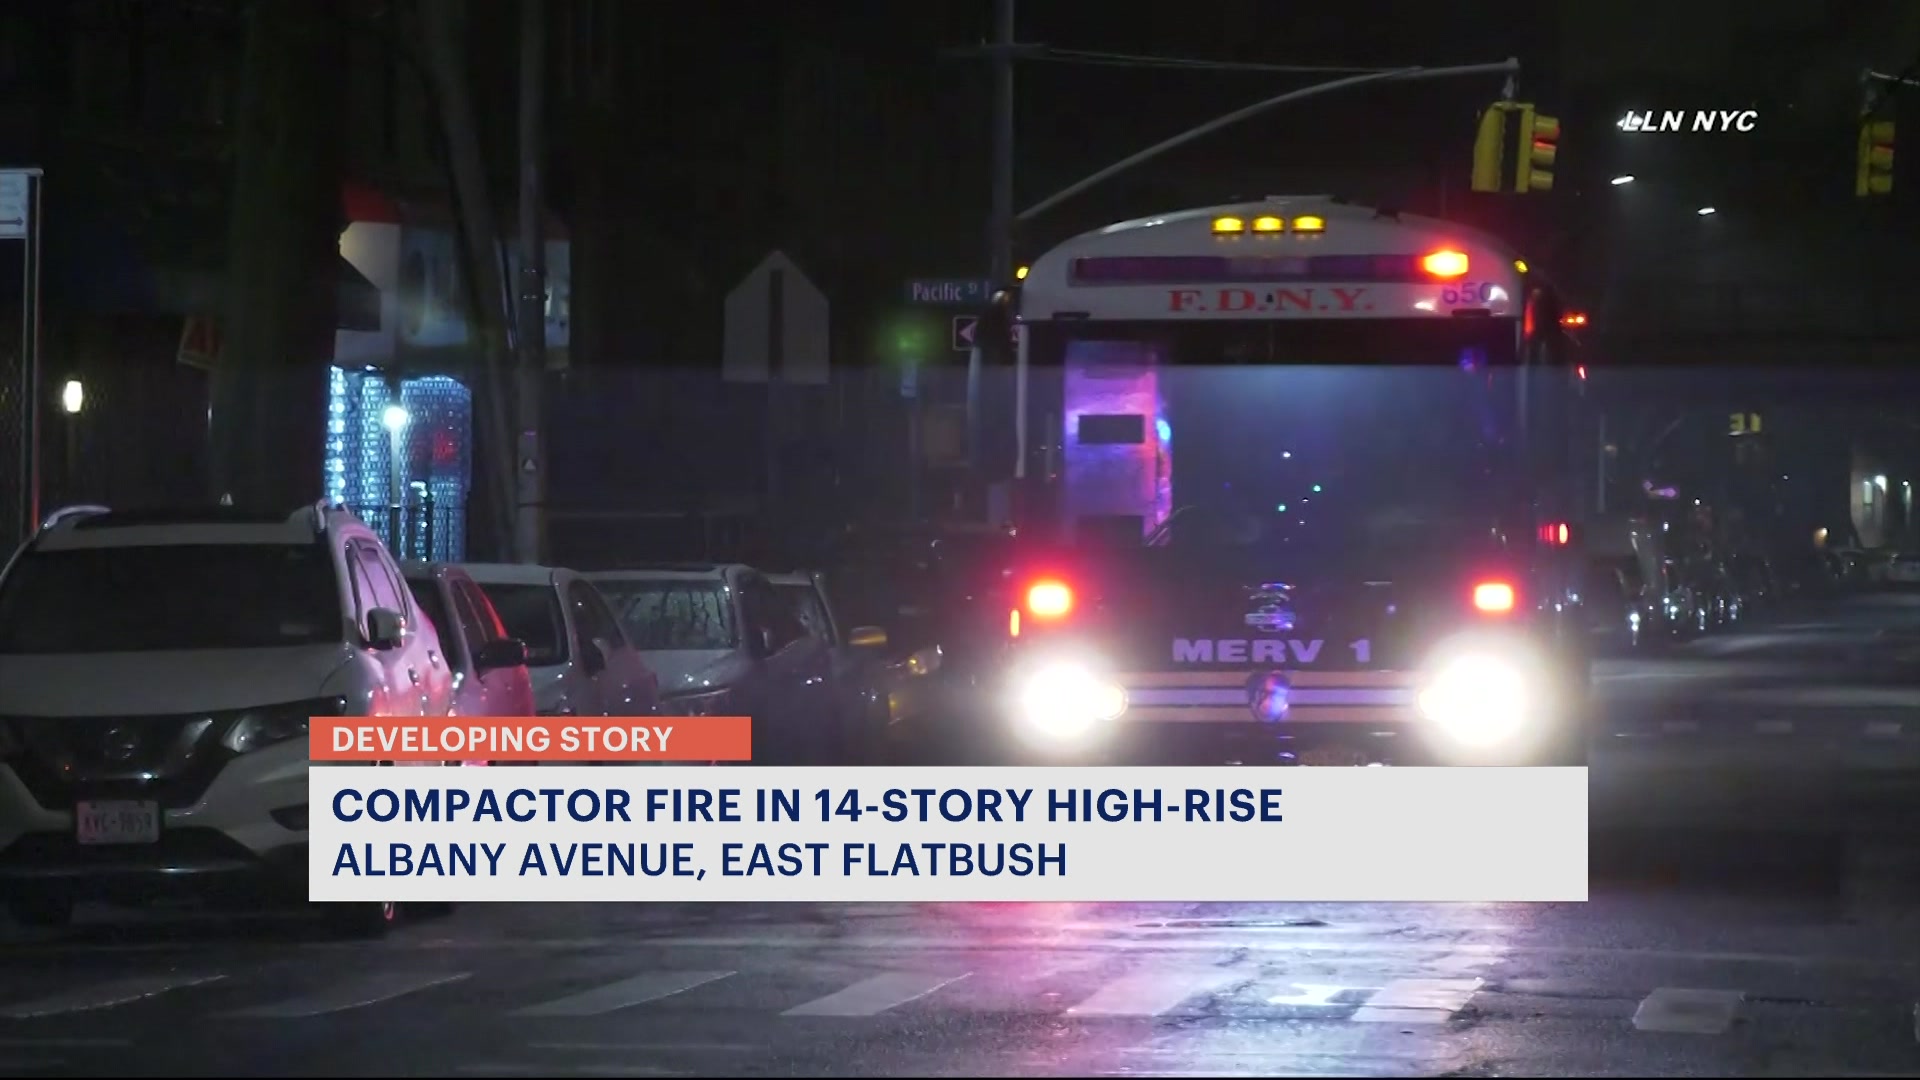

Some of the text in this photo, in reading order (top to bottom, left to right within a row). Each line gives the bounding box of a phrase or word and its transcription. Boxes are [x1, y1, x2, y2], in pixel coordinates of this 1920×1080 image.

[911, 281, 962, 301] Pacific
[1168, 288, 1374, 312] F.D.N.Y.
[1172, 638, 1371, 663] MERV 1
